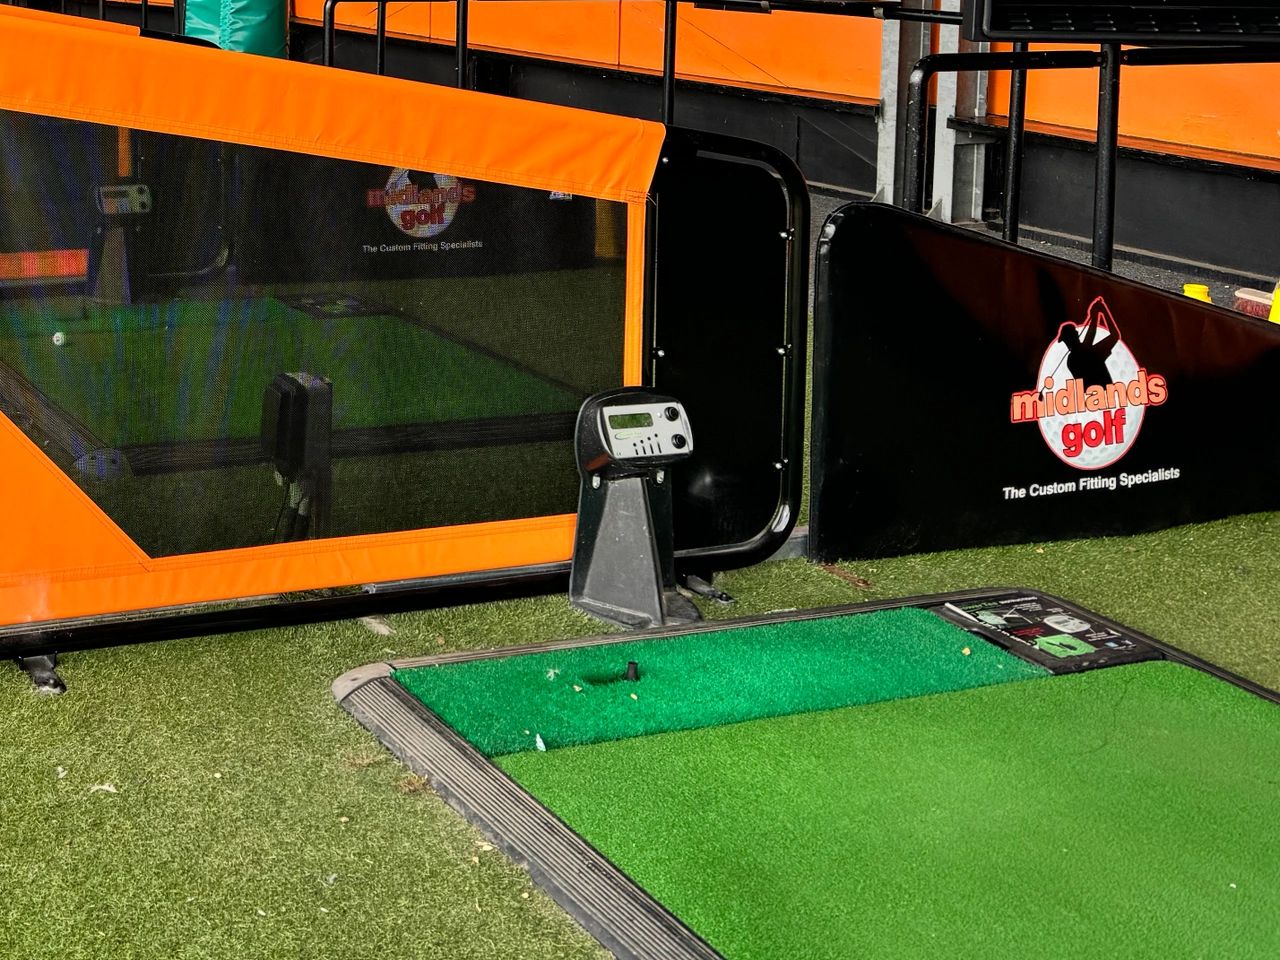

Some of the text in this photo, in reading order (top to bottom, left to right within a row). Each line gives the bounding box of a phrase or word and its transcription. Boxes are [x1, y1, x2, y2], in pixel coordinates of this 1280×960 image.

[400, 202, 445, 230] golf
[363, 240, 483, 253] The Custom Fitting Specialists
[1010, 367, 1168, 423] midlands
[1061, 408, 1127, 458] golf
[1002, 467, 1181, 500] The Custom Fitting Specialists
